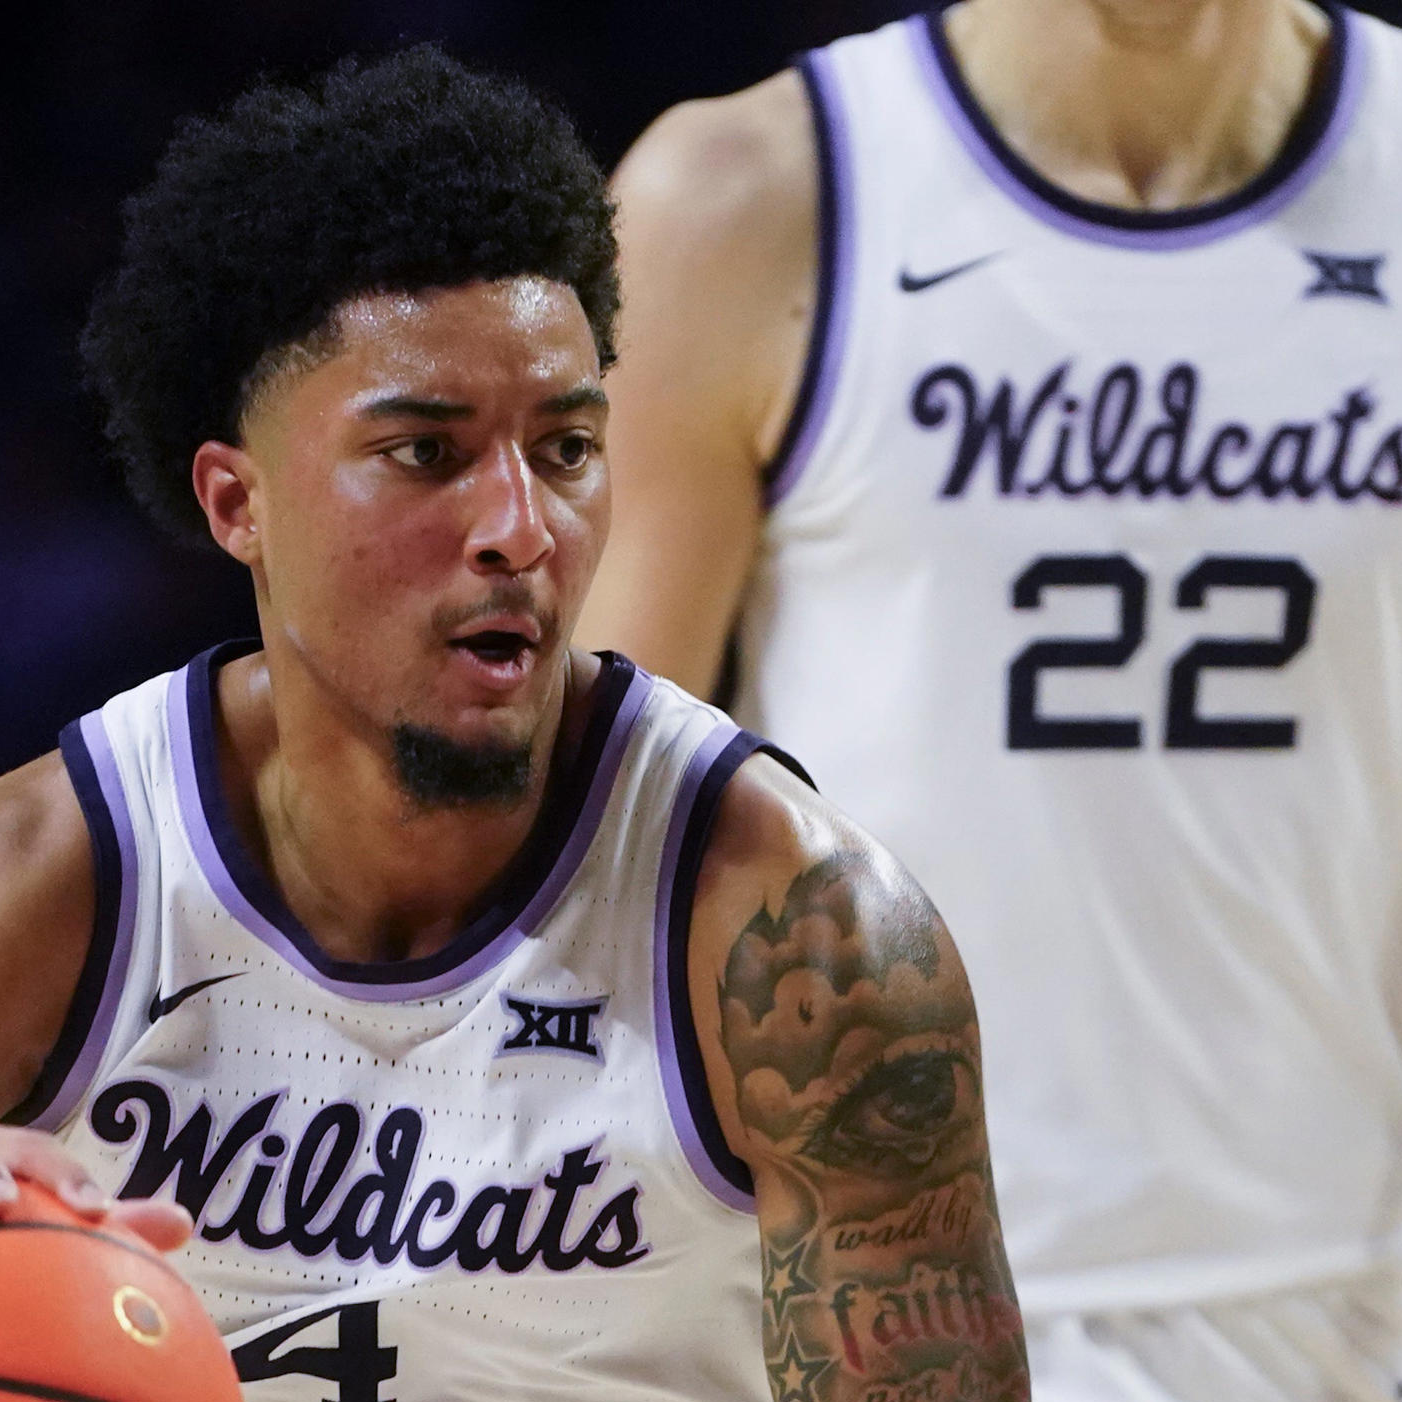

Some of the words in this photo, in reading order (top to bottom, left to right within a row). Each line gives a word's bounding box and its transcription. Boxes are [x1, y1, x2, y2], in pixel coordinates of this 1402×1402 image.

[1006, 554, 1316, 751] 22
[496, 992, 608, 1065] XII
[89, 1078, 654, 1275] Wildcats
